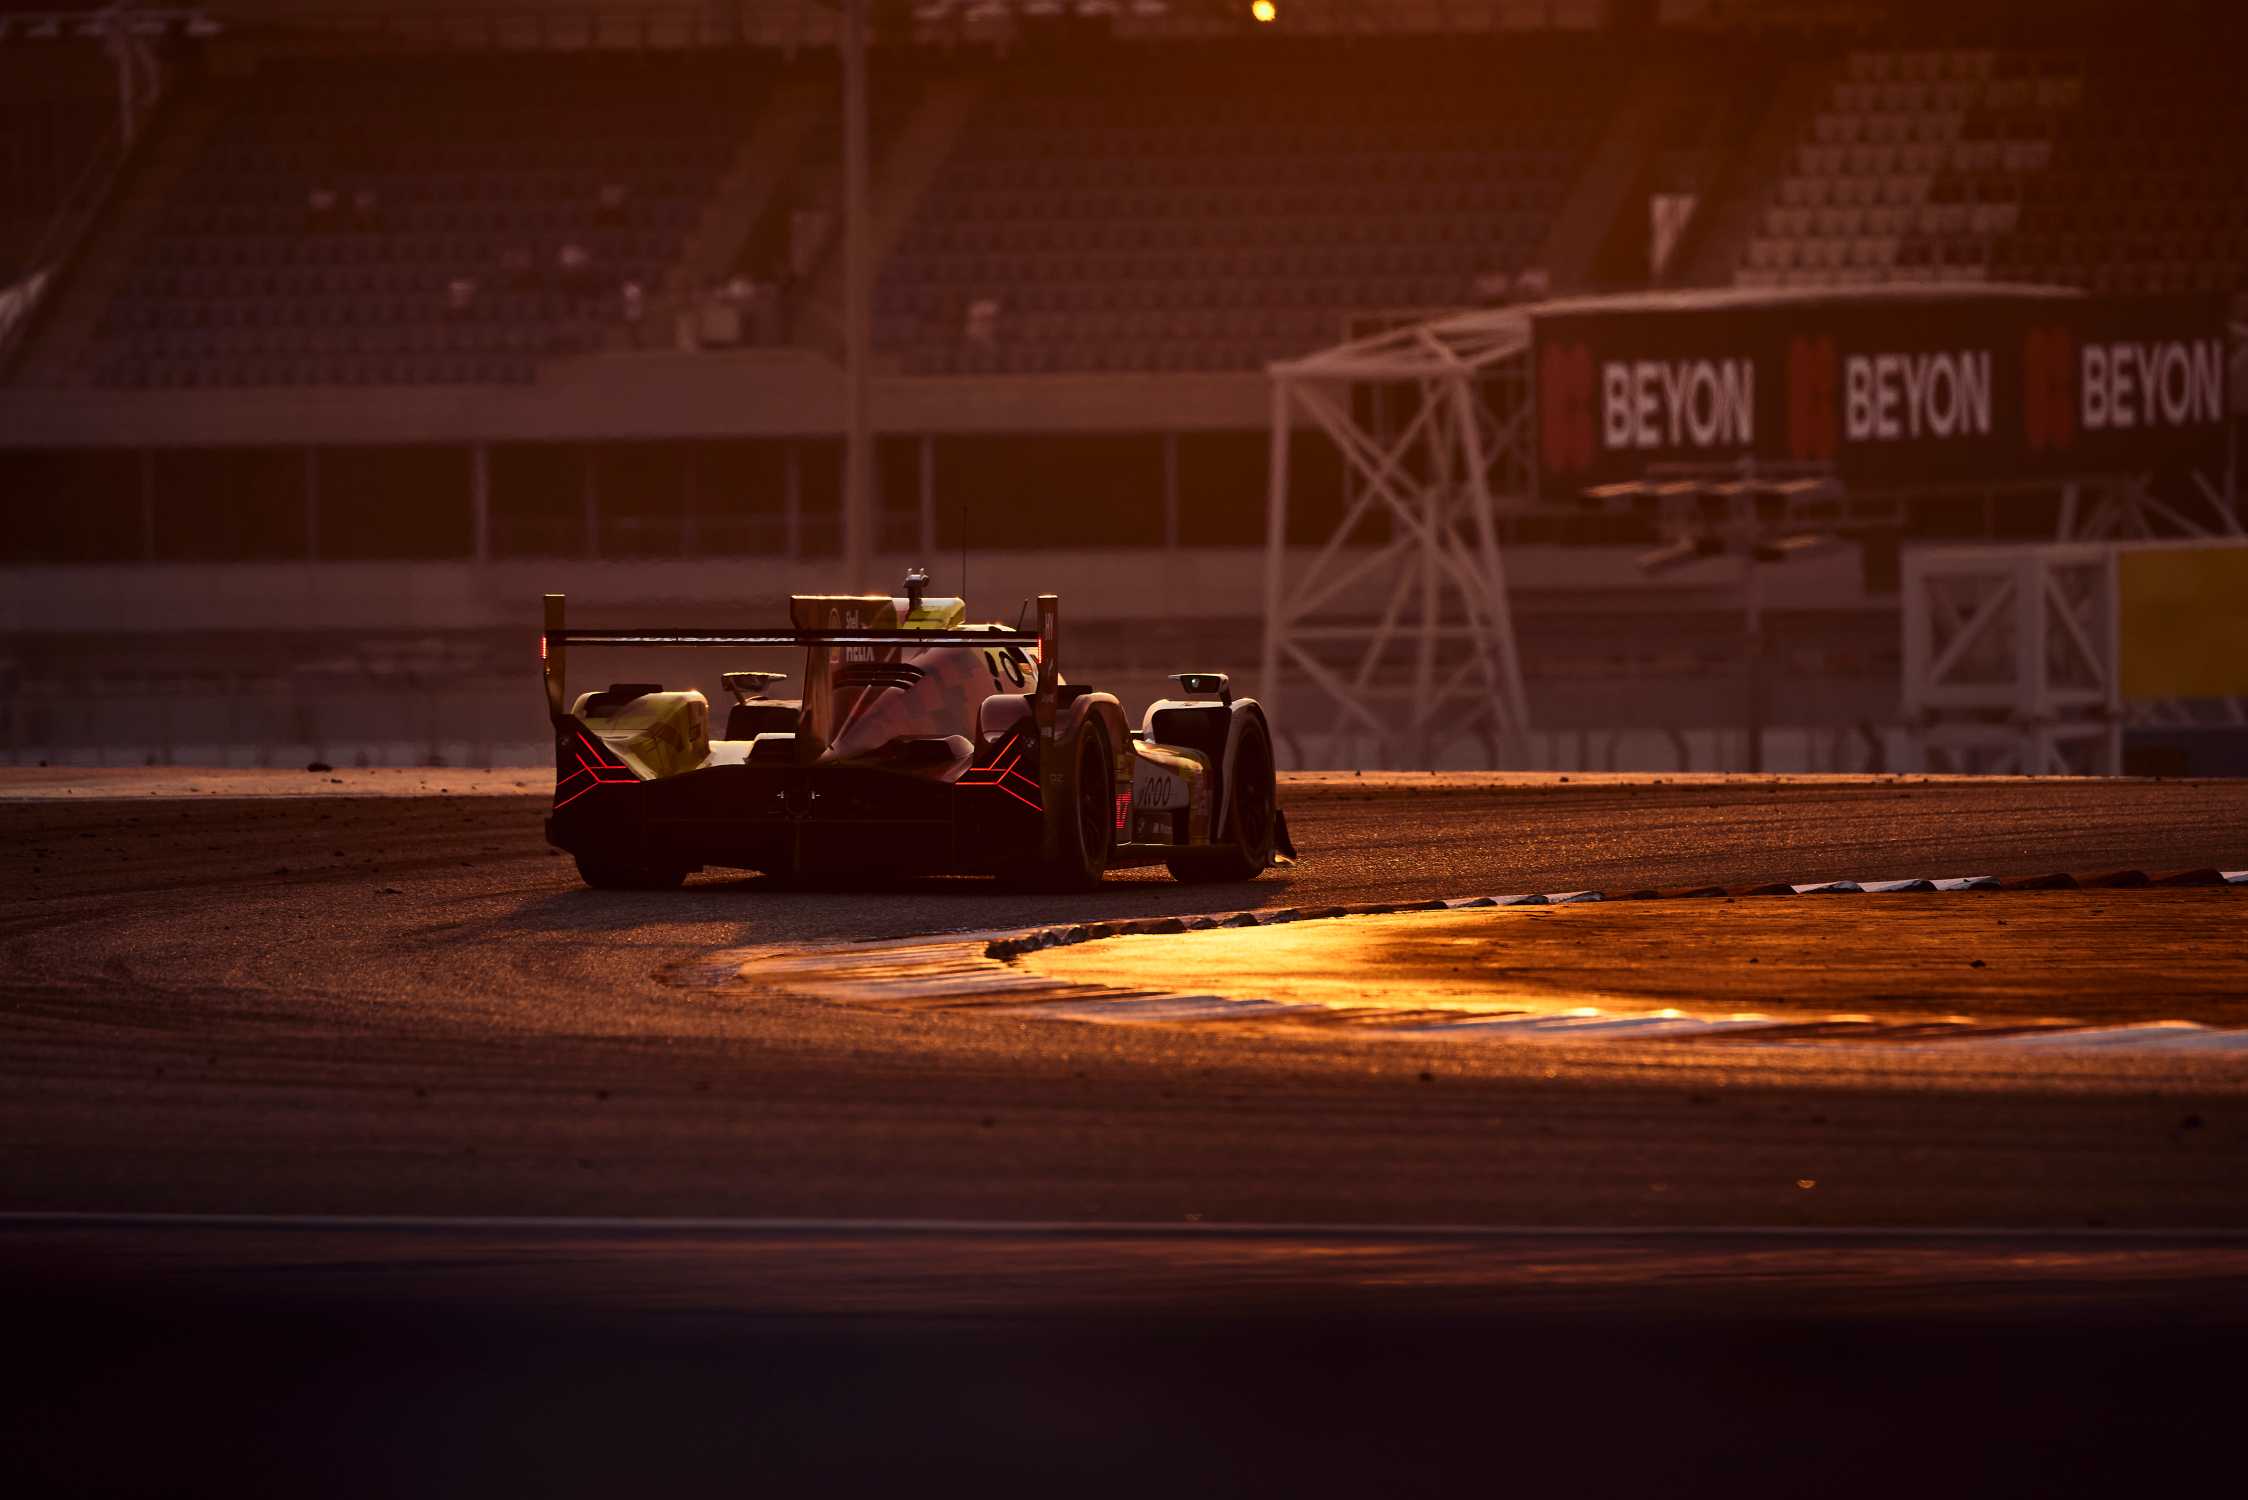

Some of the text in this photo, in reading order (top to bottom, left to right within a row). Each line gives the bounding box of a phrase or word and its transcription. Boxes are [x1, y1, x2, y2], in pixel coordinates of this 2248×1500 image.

[1603, 358, 1754, 449] BEYON
[1845, 351, 1991, 440] BEYON
[2081, 340, 2223, 428] BEYON
